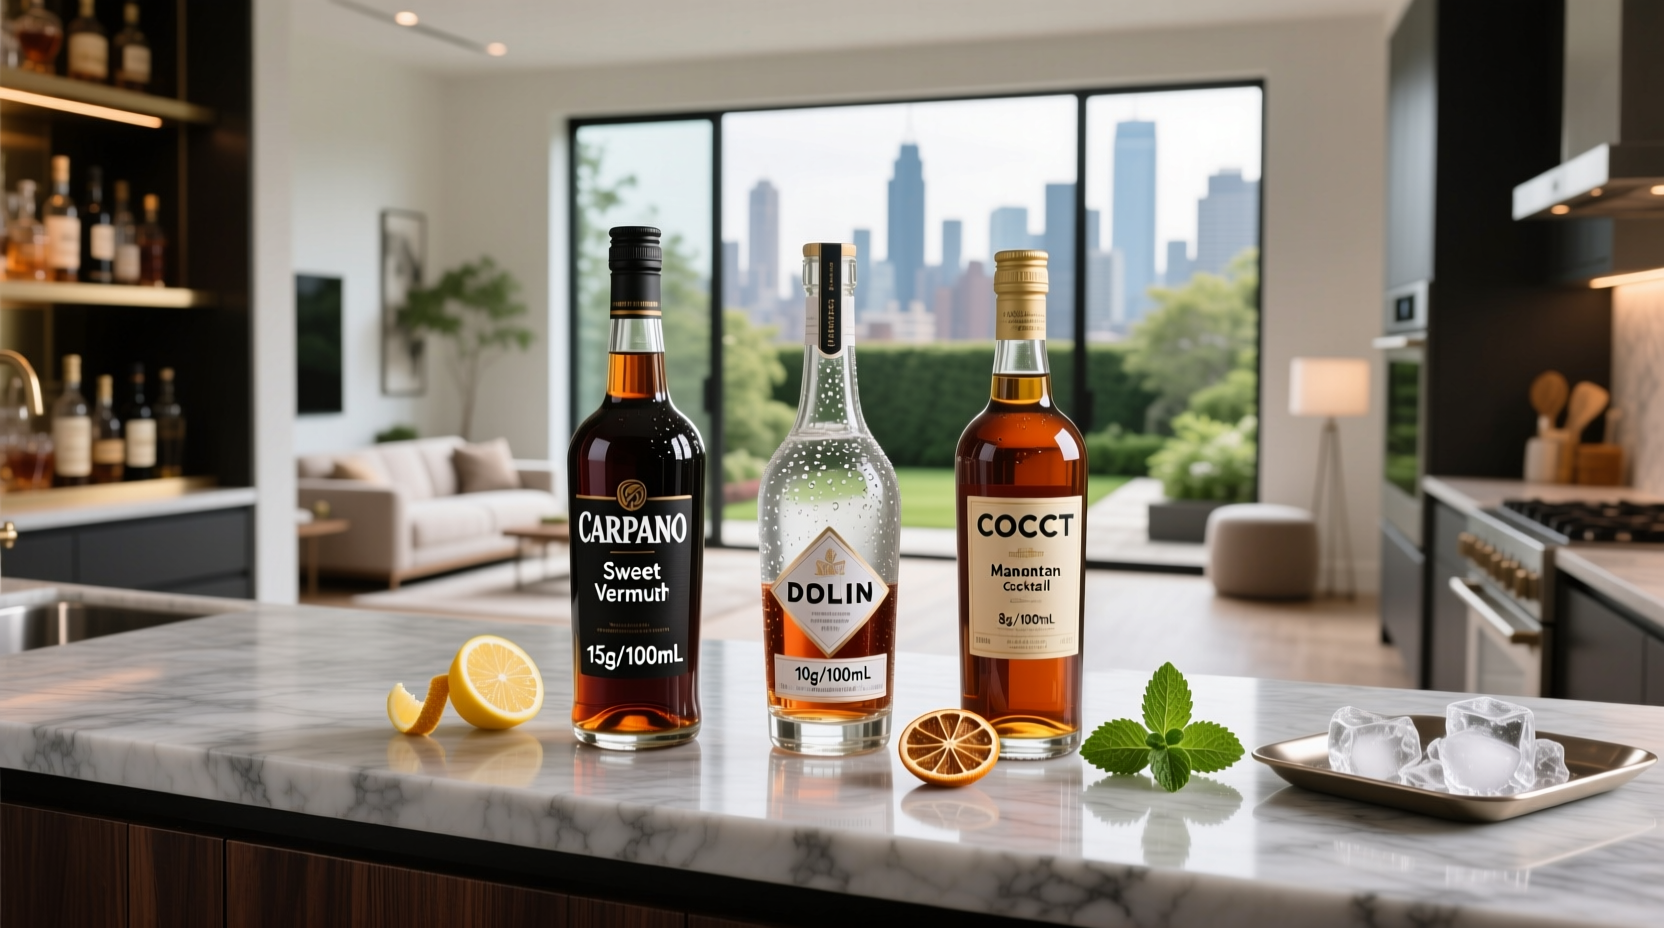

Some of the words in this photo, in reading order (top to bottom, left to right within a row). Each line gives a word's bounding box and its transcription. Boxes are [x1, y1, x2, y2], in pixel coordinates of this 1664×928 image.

[579, 511, 687, 544] CARPANO
[977, 513, 1074, 538] COCCT
[603, 561, 661, 580] Sweet
[787, 581, 873, 605] DOLIN
[586, 643, 683, 671] 15g/100mL
[795, 665, 871, 686] 10g/100mL
